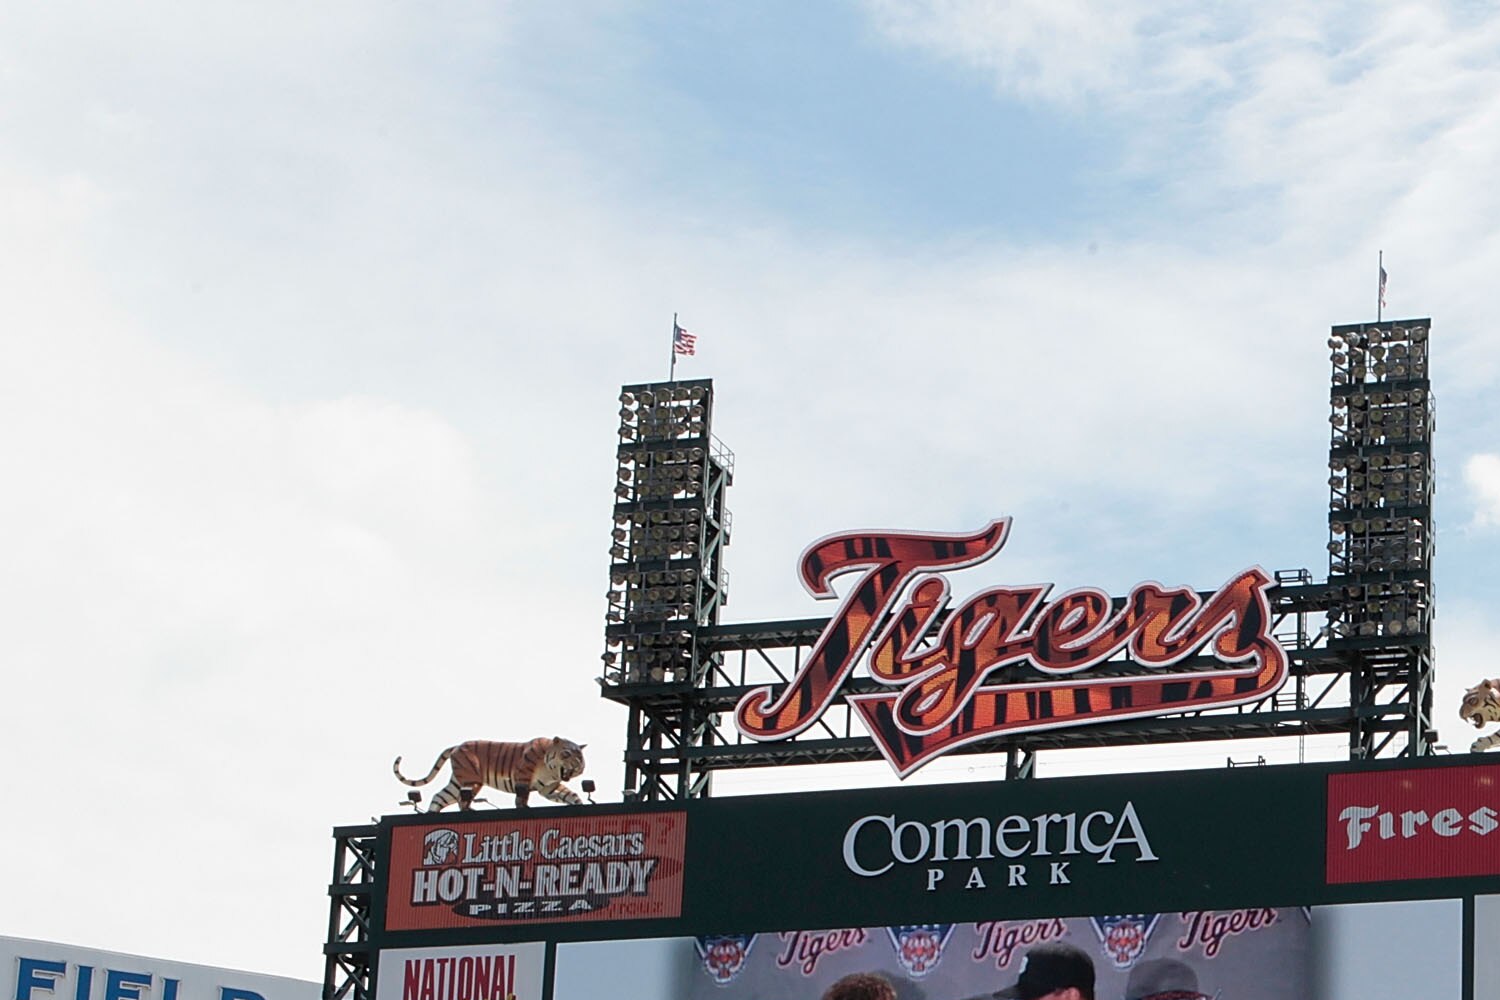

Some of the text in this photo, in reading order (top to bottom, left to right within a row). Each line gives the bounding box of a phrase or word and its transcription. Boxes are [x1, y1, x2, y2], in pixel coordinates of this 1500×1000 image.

[734, 516, 1289, 780] Tigers
[463, 831, 533, 865] Little
[540, 828, 645, 859] Caesars
[411, 859, 656, 903] HOT-N-READY
[469, 899, 593, 916] PIZZA
